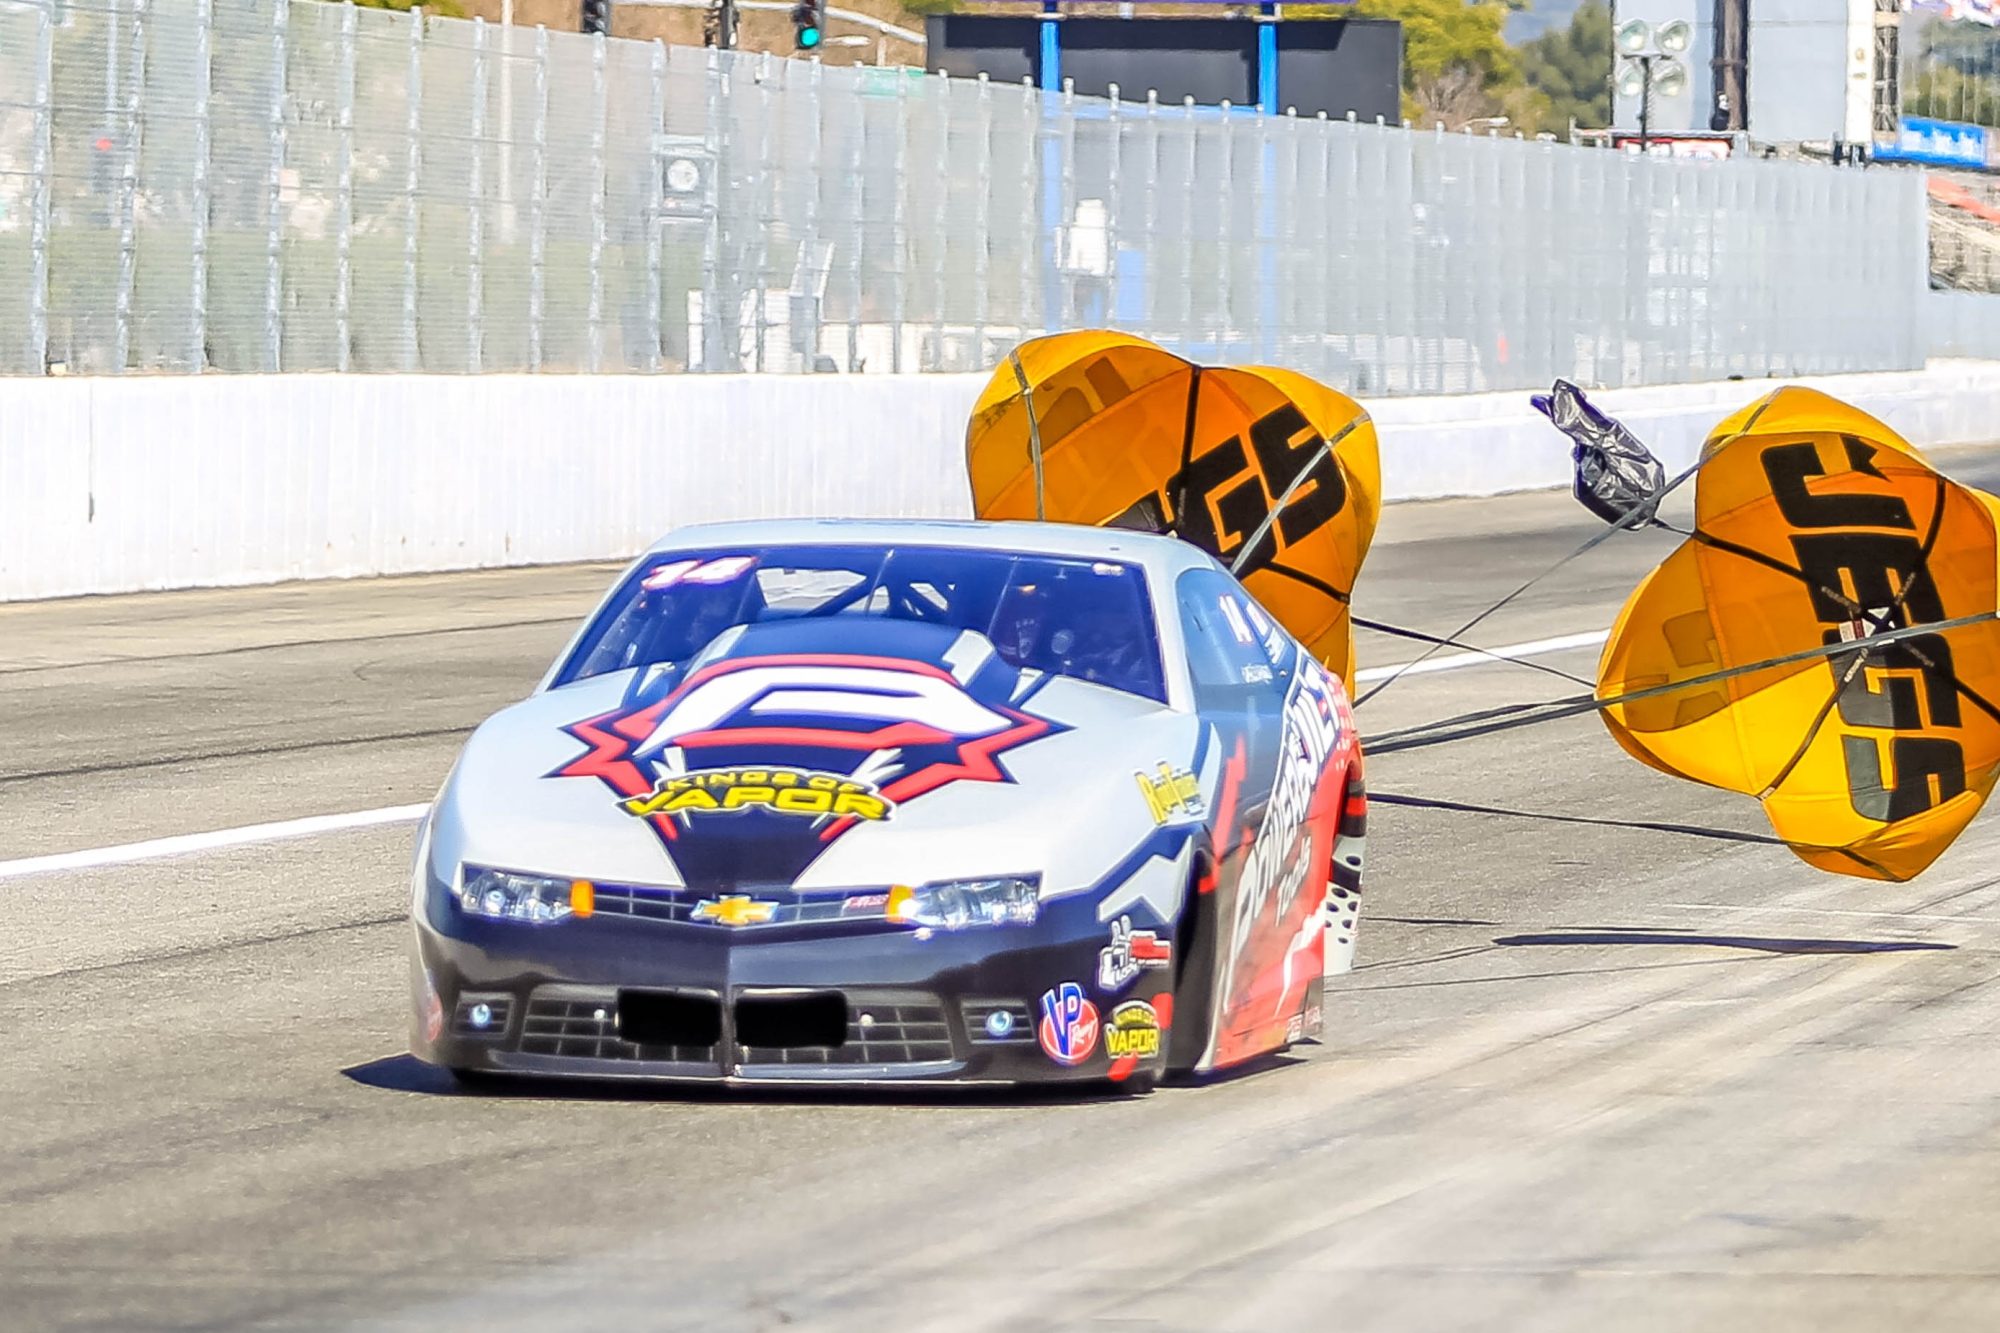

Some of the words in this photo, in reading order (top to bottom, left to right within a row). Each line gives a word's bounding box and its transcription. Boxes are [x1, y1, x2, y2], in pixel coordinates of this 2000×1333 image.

[1108, 401, 1347, 582] GS
[640, 555, 758, 590] 14
[1760, 433, 1967, 823] JEGS
[667, 769, 797, 791] KINGS
[807, 776, 866, 793] OF
[625, 786, 888, 820] VAPOR
[1043, 983, 1083, 1058] VP
[1107, 1028, 1158, 1054] VAPOR
